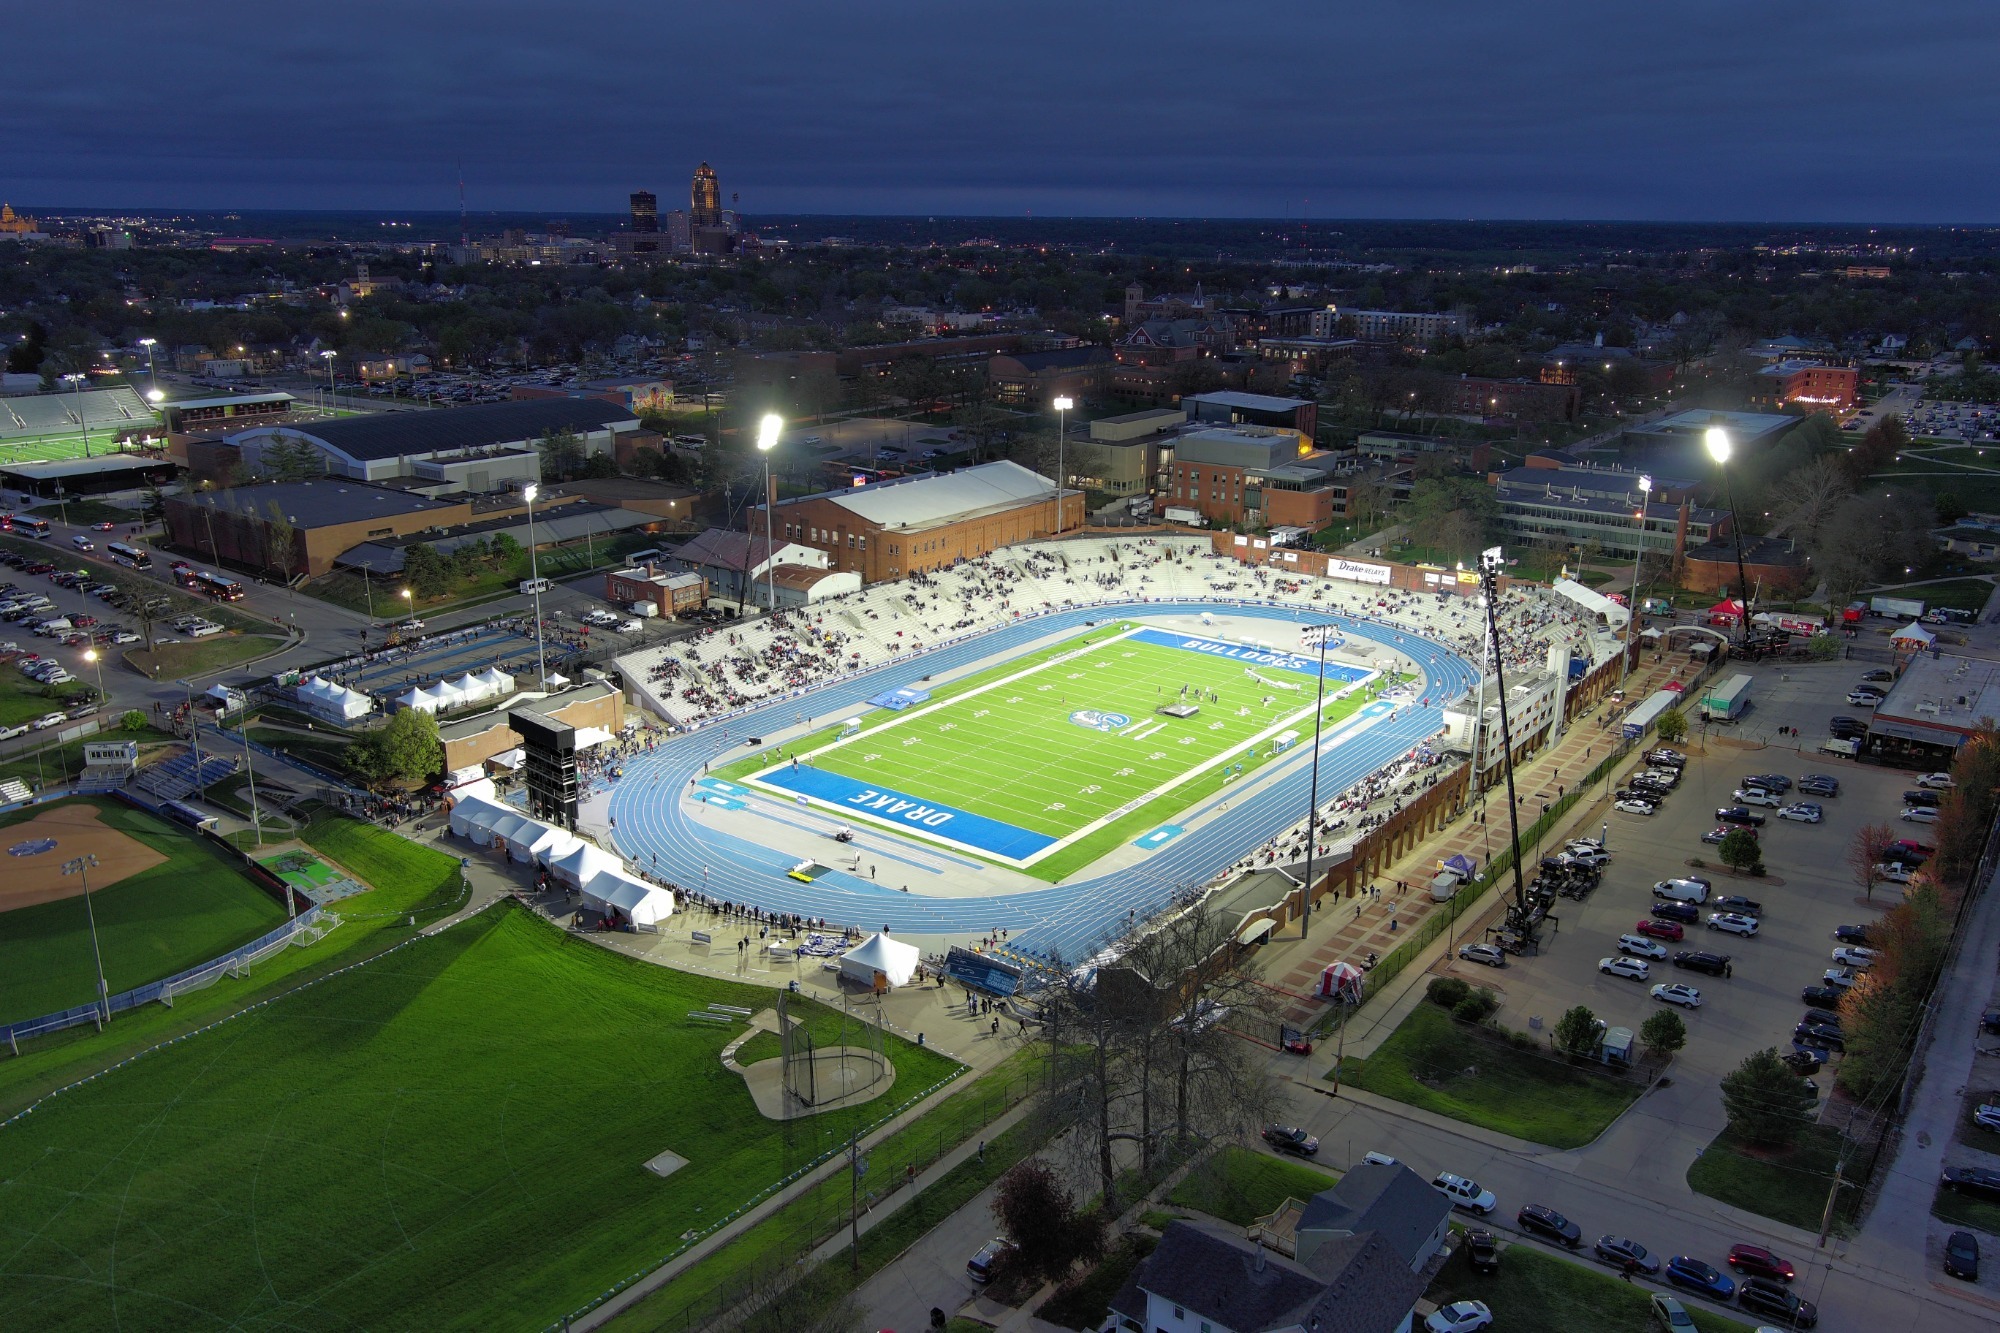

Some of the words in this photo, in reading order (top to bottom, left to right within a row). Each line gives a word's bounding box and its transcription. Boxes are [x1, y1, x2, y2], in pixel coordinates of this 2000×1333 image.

[1338, 560, 1364, 573] Drake
[1364, 567, 1386, 576] RELAYS
[1181, 639, 1308, 669] BULLDOGS
[847, 789, 955, 827] DRAKE
